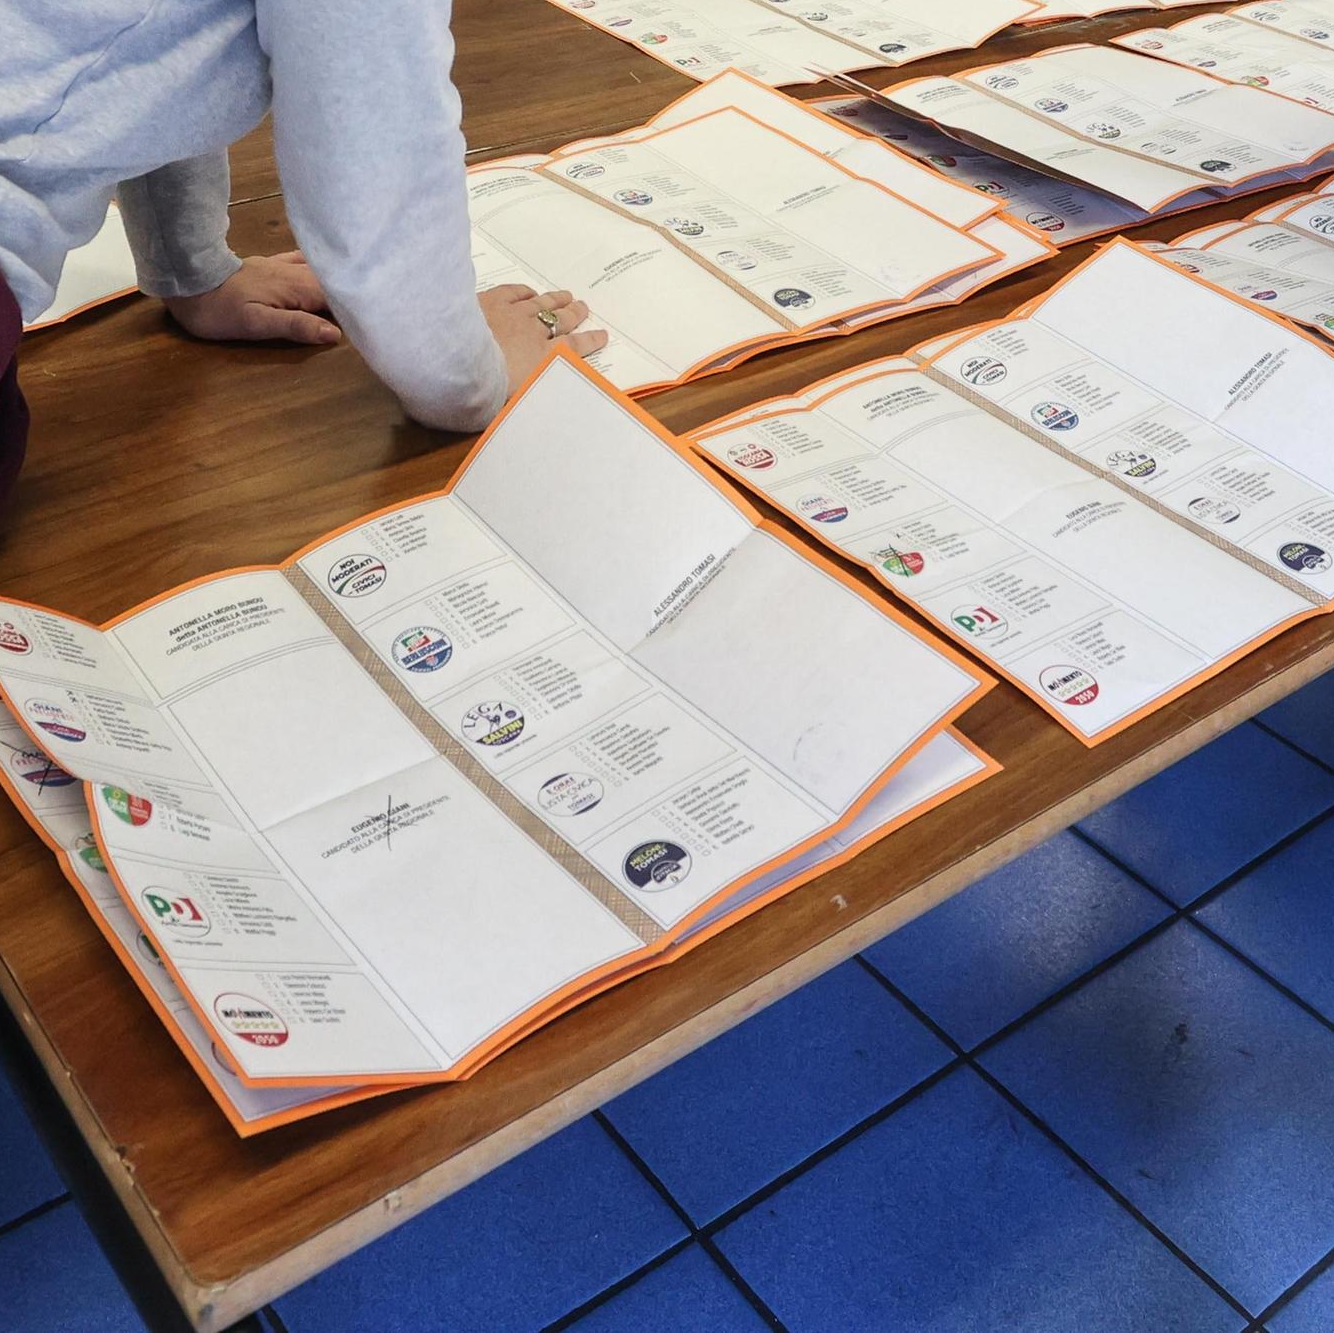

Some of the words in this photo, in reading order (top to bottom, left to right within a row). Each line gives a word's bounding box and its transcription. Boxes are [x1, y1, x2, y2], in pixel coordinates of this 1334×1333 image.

[331, 558, 373, 584] MODERATI
[339, 558, 355, 570] NOI
[351, 573, 376, 589] CIVICI
[355, 576, 383, 595] TOMASI
[653, 576, 694, 617] ALESSANDRO
[690, 553, 716, 579] TOMASI
[168, 612, 214, 637] ANTONELLA
[197, 611, 241, 632] ANTONELLA
[463, 702, 503, 729] LEGA
[482, 718, 524, 745] SALVINI
[350, 812, 387, 834] EUGENIO
[321, 835, 362, 860] CANDIDATO
